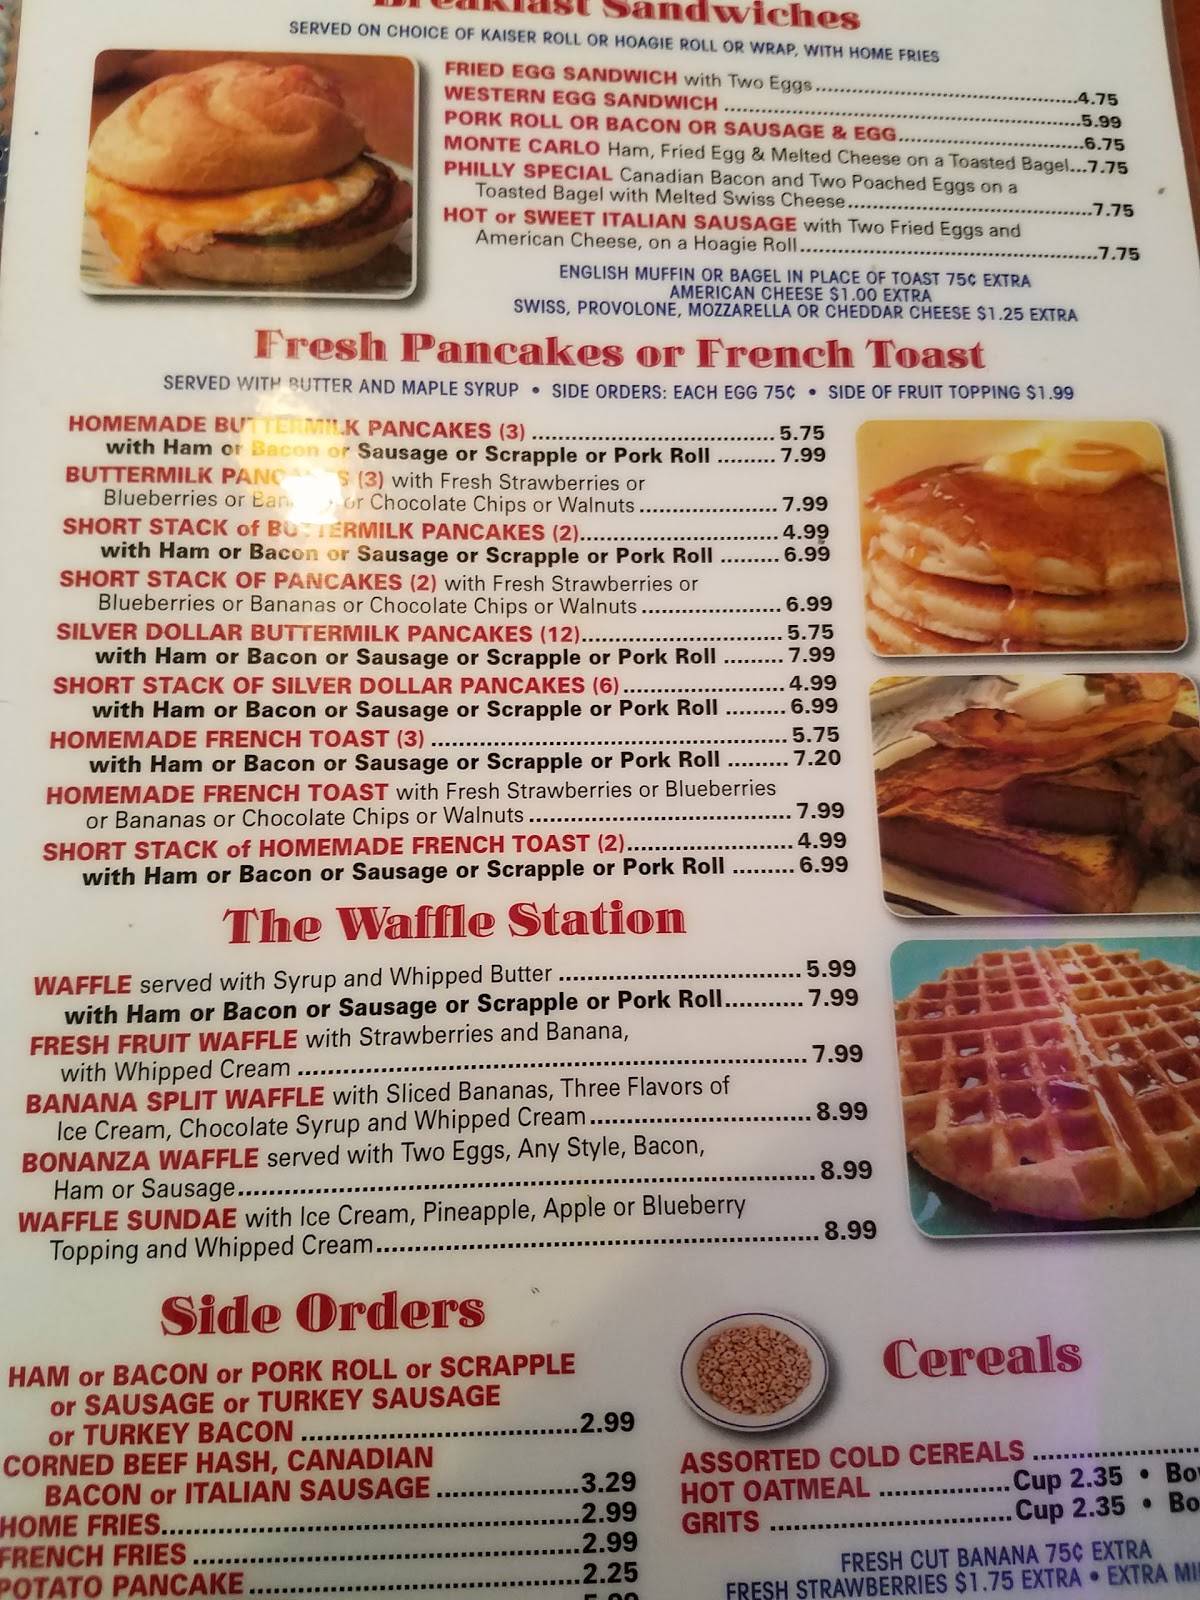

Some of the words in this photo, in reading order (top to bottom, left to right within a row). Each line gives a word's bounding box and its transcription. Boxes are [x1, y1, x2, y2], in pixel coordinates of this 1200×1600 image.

[602, 0, 861, 31] Sandwiches
[289, 21, 352, 36] SERVED
[358, 23, 381, 37] ON
[387, 24, 448, 40] CHOICE
[455, 27, 474, 40] OF
[481, 28, 536, 43] KAISER
[543, 31, 581, 46] ROLL
[587, 33, 608, 47] OR
[615, 35, 673, 50] HOAGIE
[680, 38, 717, 52] ROLL
[723, 40, 744, 53] OR
[749, 41, 798, 57] WRAP,
[803, 44, 843, 58] WITH
[849, 46, 893, 61] HOME
[898, 48, 940, 63] FRIES
[445, 61, 504, 78] FRIED
[512, 64, 555, 80] EGG
[563, 66, 678, 85] SANDWICH
[684, 73, 721, 87] with
[728, 73, 764, 89] Two
[769, 75, 812, 94] Eggs
[1076, 91, 1119, 106] 4.75
[444, 85, 546, 104] WESTERN
[552, 90, 596, 106] EGG
[604, 92, 718, 111] SANDWICH
[1081, 114, 1122, 129] 5.99
[444, 135, 521, 153] MONTE
[528, 138, 600, 156] CARLO
[608, 142, 654, 160] Ham,
[661, 143, 705, 159] Fried
[711, 145, 745, 164] Egg
[751, 146, 765, 161] &
[771, 147, 831, 164] Melted
[837, 149, 901, 166] Cheese
[907, 156, 928, 166] on
[934, 157, 944, 167] a
[948, 153, 1016, 170] Toasted
[1021, 156, 1072, 175] Bagel
[1087, 160, 1129, 175] 7.75
[475, 182, 546, 200] Toasted
[553, 185, 603, 205] Bagel
[609, 187, 648, 203] with
[656, 188, 716, 205] Melted
[723, 190, 775, 207] Swiss
[781, 192, 845, 208] Cheese
[1092, 202, 1135, 218] 7.75
[560, 264, 628, 280] ENGLISH
[635, 266, 695, 281] MUFFIN
[701, 268, 723, 282] OR
[730, 268, 781, 283] BAGEL
[787, 269, 803, 284] IN
[810, 269, 860, 284] PLACE
[866, 270, 886, 285] OF
[891, 271, 940, 286] TOAST
[946, 272, 977, 287] 75¢
[983, 273, 1032, 288] EXTRA
[669, 284, 755, 300] AMERICAN
[761, 286, 823, 301] CHEESE
[830, 286, 877, 303] $1.00
[883, 288, 932, 303] EXTRA
[255, 329, 388, 362] Fresh
[400, 332, 624, 367] Pancakes
[636, 345, 685, 368] or
[696, 338, 855, 368] French
[865, 339, 986, 369] Toast
[163, 375, 230, 390] SERVED
[237, 376, 281, 391] WITH
[289, 377, 352, 393] BUTTER
[359, 379, 395, 394] AND
[402, 380, 458, 396] MAPLE
[464, 381, 519, 397] SYRUP
[552, 383, 589, 399] SIDE
[596, 384, 667, 400] ORDERS:
[674, 385, 717, 400] EACH
[724, 385, 758, 400] EGG
[764, 384, 795, 400] 75¢
[828, 385, 866, 399] SIDE
[872, 384, 892, 399] OF
[898, 384, 943, 399] FRUIT
[948, 385, 1021, 400] TOPPING
[1026, 384, 1074, 400] $1.99
[59, 569, 140, 588] SHORT
[147, 570, 227, 589] STACK
[235, 571, 267, 589] OF
[274, 572, 402, 591] PANCAKES
[410, 574, 437, 593] (2)
[444, 574, 485, 592] with
[493, 575, 544, 592] Fresh
[552, 575, 673, 592] Strawberries
[679, 579, 699, 592] or
[49, 730, 197, 749] HOMEMADE
[205, 730, 301, 748] FRENCH
[309, 729, 390, 748] TOAST
[397, 729, 424, 749] (3)
[792, 726, 840, 743] 5.75
[86, 816, 108, 829] or
[115, 810, 206, 829] Bananas
[213, 814, 236, 827] or
[242, 808, 345, 827] Chocolate
[353, 807, 409, 829] Chips
[416, 811, 438, 824] or
[443, 806, 524, 824] Walnuts
[796, 802, 845, 819] 7.99
[222, 907, 322, 944] The
[335, 904, 496, 941] Waffle
[508, 899, 687, 937] Station
[34, 974, 132, 996] WAFFLE
[140, 972, 212, 994] served
[219, 971, 265, 991] with
[273, 970, 336, 994] Syrup
[344, 967, 382, 988] and
[389, 964, 482, 990] Whipped
[491, 964, 553, 983] Butter
[806, 959, 856, 978] 5.99
[60, 1062, 106, 1082] with
[114, 1059, 212, 1086] Whipped
[220, 1058, 290, 1079] Cream
[812, 1044, 863, 1063] 7.99
[49, 1239, 139, 1266] Topping
[146, 1237, 187, 1259] and
[194, 1234, 294, 1262] Whipped
[302, 1234, 373, 1255] Cream
[824, 1219, 877, 1241] 8.99
[160, 1294, 282, 1336] Side
[296, 1290, 486, 1333] Orders
[883, 1334, 1083, 1380] Cereals
[48, 1430, 75, 1447] or
[83, 1422, 190, 1446] TURKEY
[198, 1420, 293, 1444] BACON
[580, 1411, 635, 1434] 2.99
[3, 1453, 114, 1478] CORNED
[123, 1452, 188, 1476] BEEF
[196, 1450, 278, 1475] HASH,
[287, 1445, 433, 1472] CANADIAN
[680, 1448, 821, 1475] ASSORTED
[829, 1445, 900, 1469] COLD
[908, 1439, 1025, 1466] CEREALS
[681, 1480, 735, 1504] HOT
[743, 1476, 871, 1502] OATMEAL
[1013, 1469, 1062, 1496] Cup
[1070, 1465, 1123, 1489] 2.35
[0, 1514, 78, 1538] HOME
[87, 1512, 161, 1537] FRIES
[581, 1501, 638, 1524] 2.99
[0, 1544, 104, 1569] FRENCH
[113, 1542, 186, 1567] FRIES
[582, 1531, 638, 1554] 2.99
[841, 1550, 903, 1573] FRESH
[910, 1548, 950, 1570] CUT
[957, 1544, 1040, 1568] BANANA
[1045, 1542, 1083, 1564] 75¢
[1091, 1539, 1152, 1562] EXTRA
